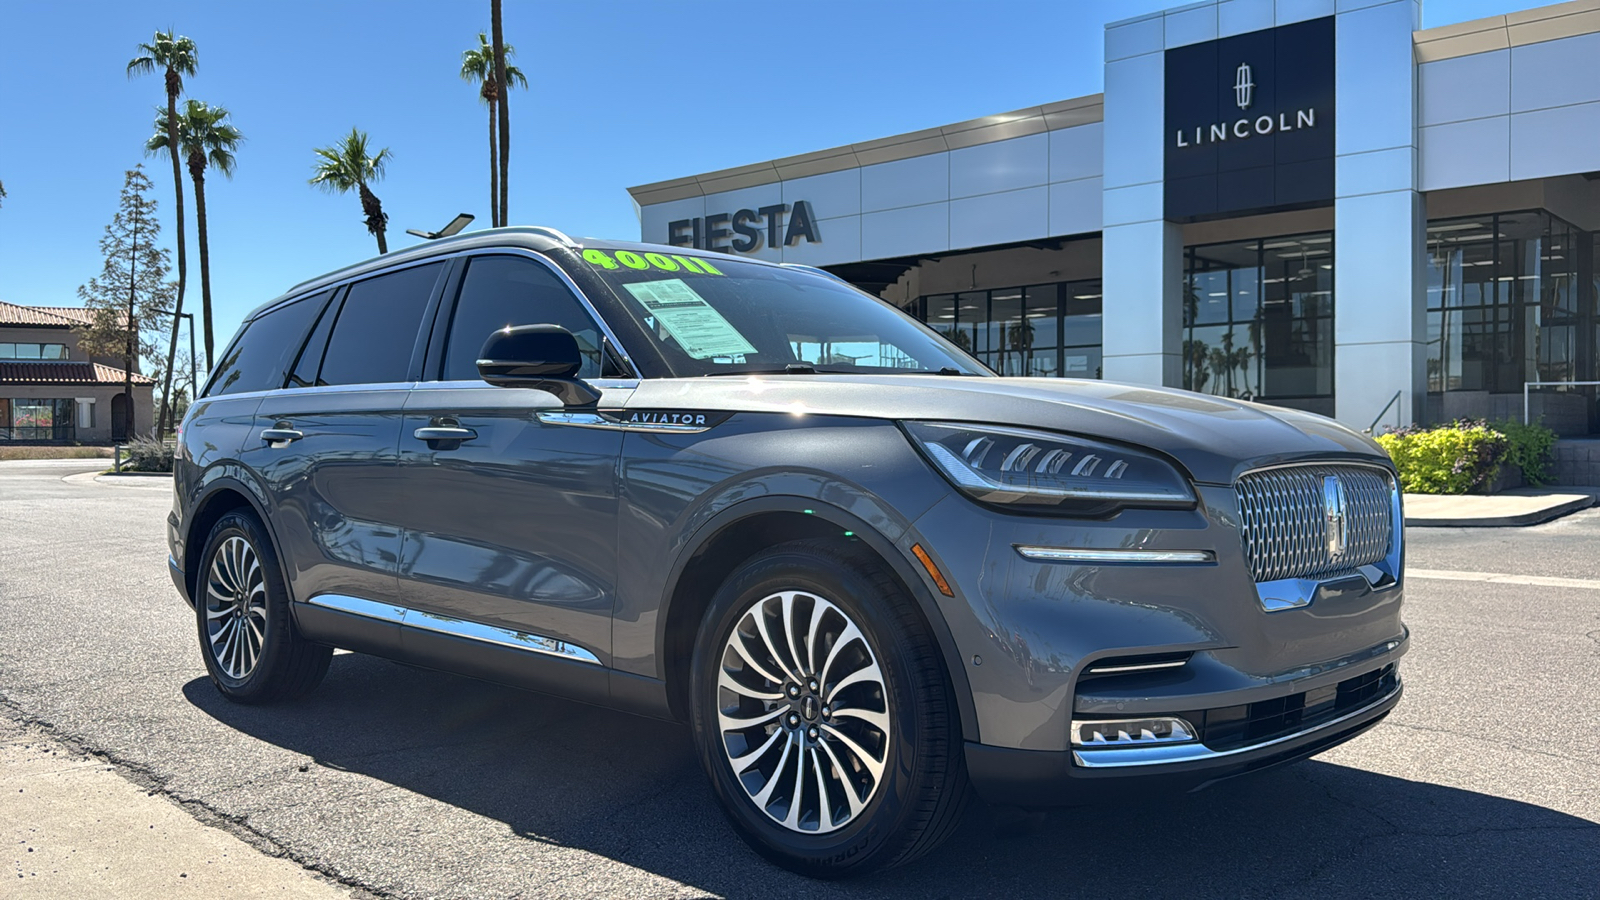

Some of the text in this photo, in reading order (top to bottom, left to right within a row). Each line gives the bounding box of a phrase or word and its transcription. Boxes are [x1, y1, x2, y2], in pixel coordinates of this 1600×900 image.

[1176, 108, 1315, 148] LINCOLN
[668, 200, 821, 254] FIESTA
[582, 249, 724, 276] 40011
[630, 411, 706, 425] AVIATOR
